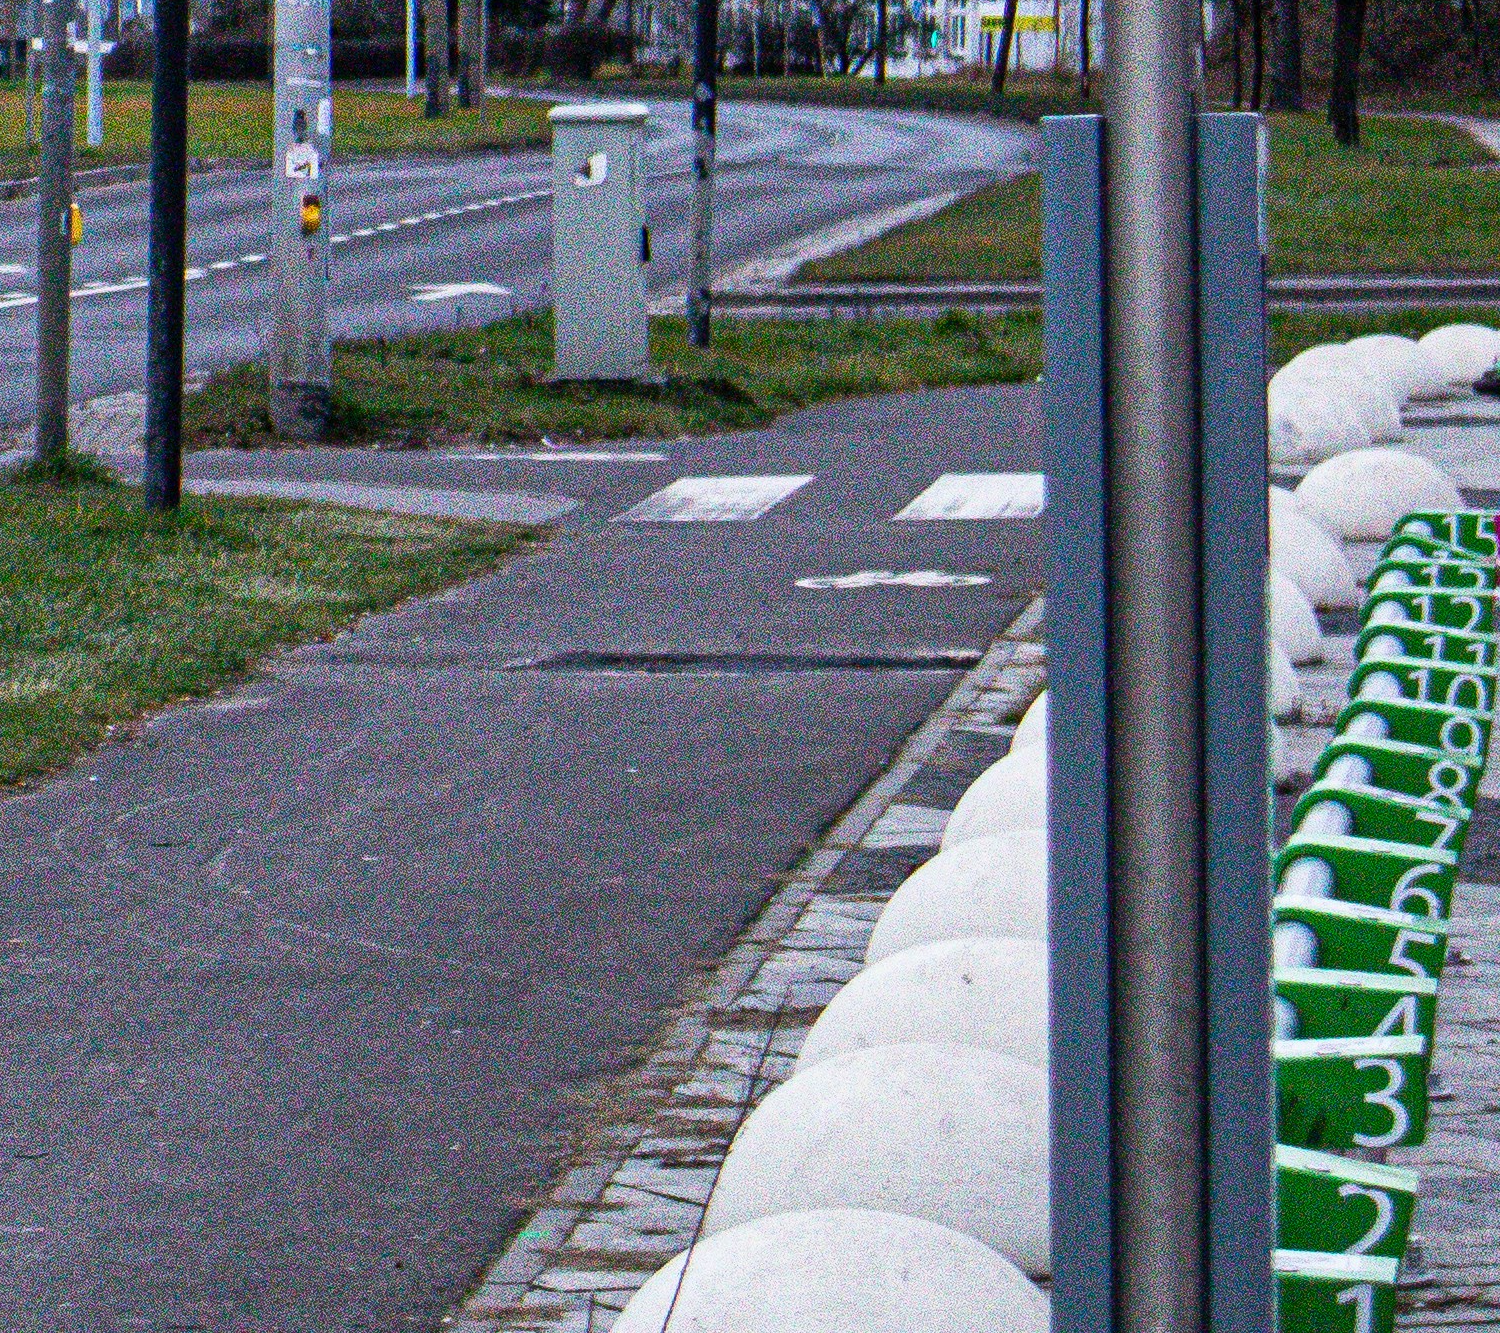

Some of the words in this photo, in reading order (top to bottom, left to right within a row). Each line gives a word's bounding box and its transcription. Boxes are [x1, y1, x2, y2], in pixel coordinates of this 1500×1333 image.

[1425, 760, 1469, 809] 8
[1416, 810, 1459, 850] 7
[1390, 862, 1443, 919] 6
[1389, 930, 1440, 978] 5
[1353, 1058, 1411, 1147] 3
[1339, 1184, 1394, 1255] 2
